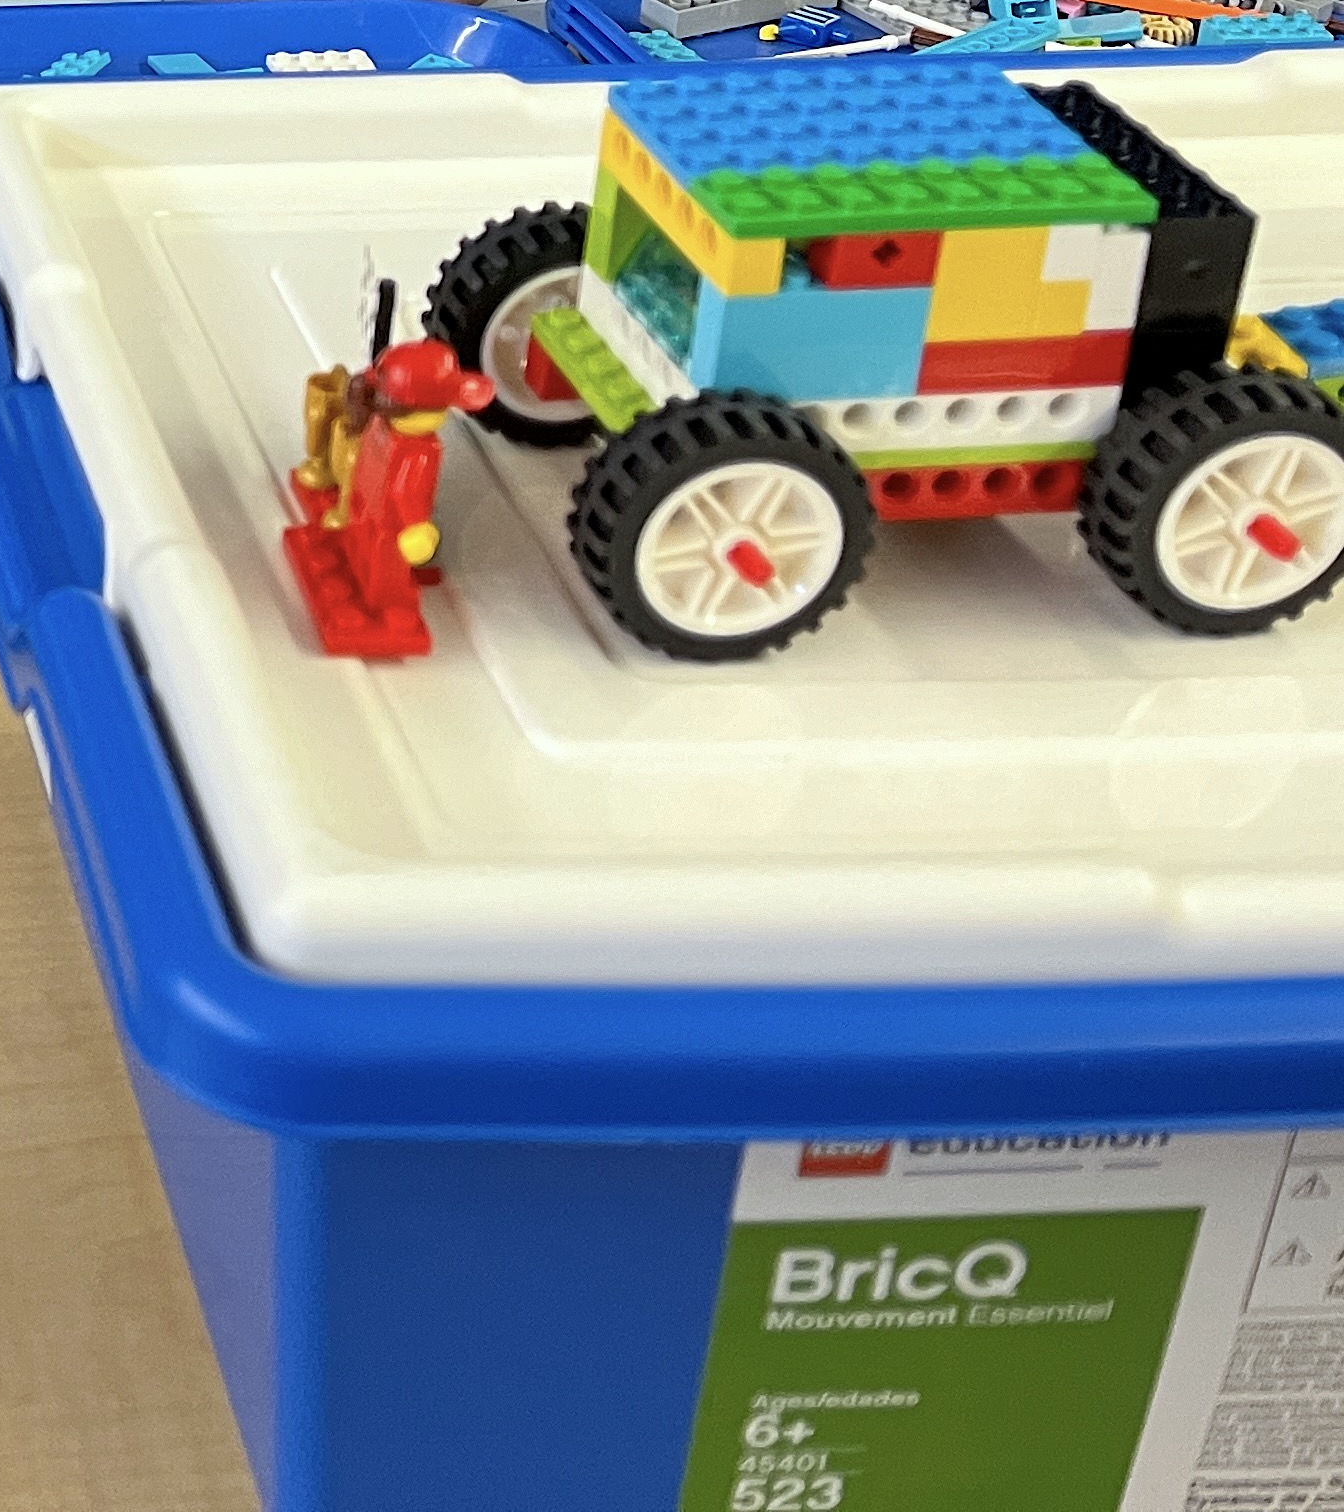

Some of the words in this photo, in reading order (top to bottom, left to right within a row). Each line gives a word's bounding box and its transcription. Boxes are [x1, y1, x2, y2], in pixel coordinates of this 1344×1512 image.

[771, 1241, 1028, 1303] BricQ
[766, 1305, 959, 1331] Mouvement
[745, 1412, 816, 1448] 6+
[738, 1453, 830, 1473] 45401
[731, 1475, 844, 1512] 523
